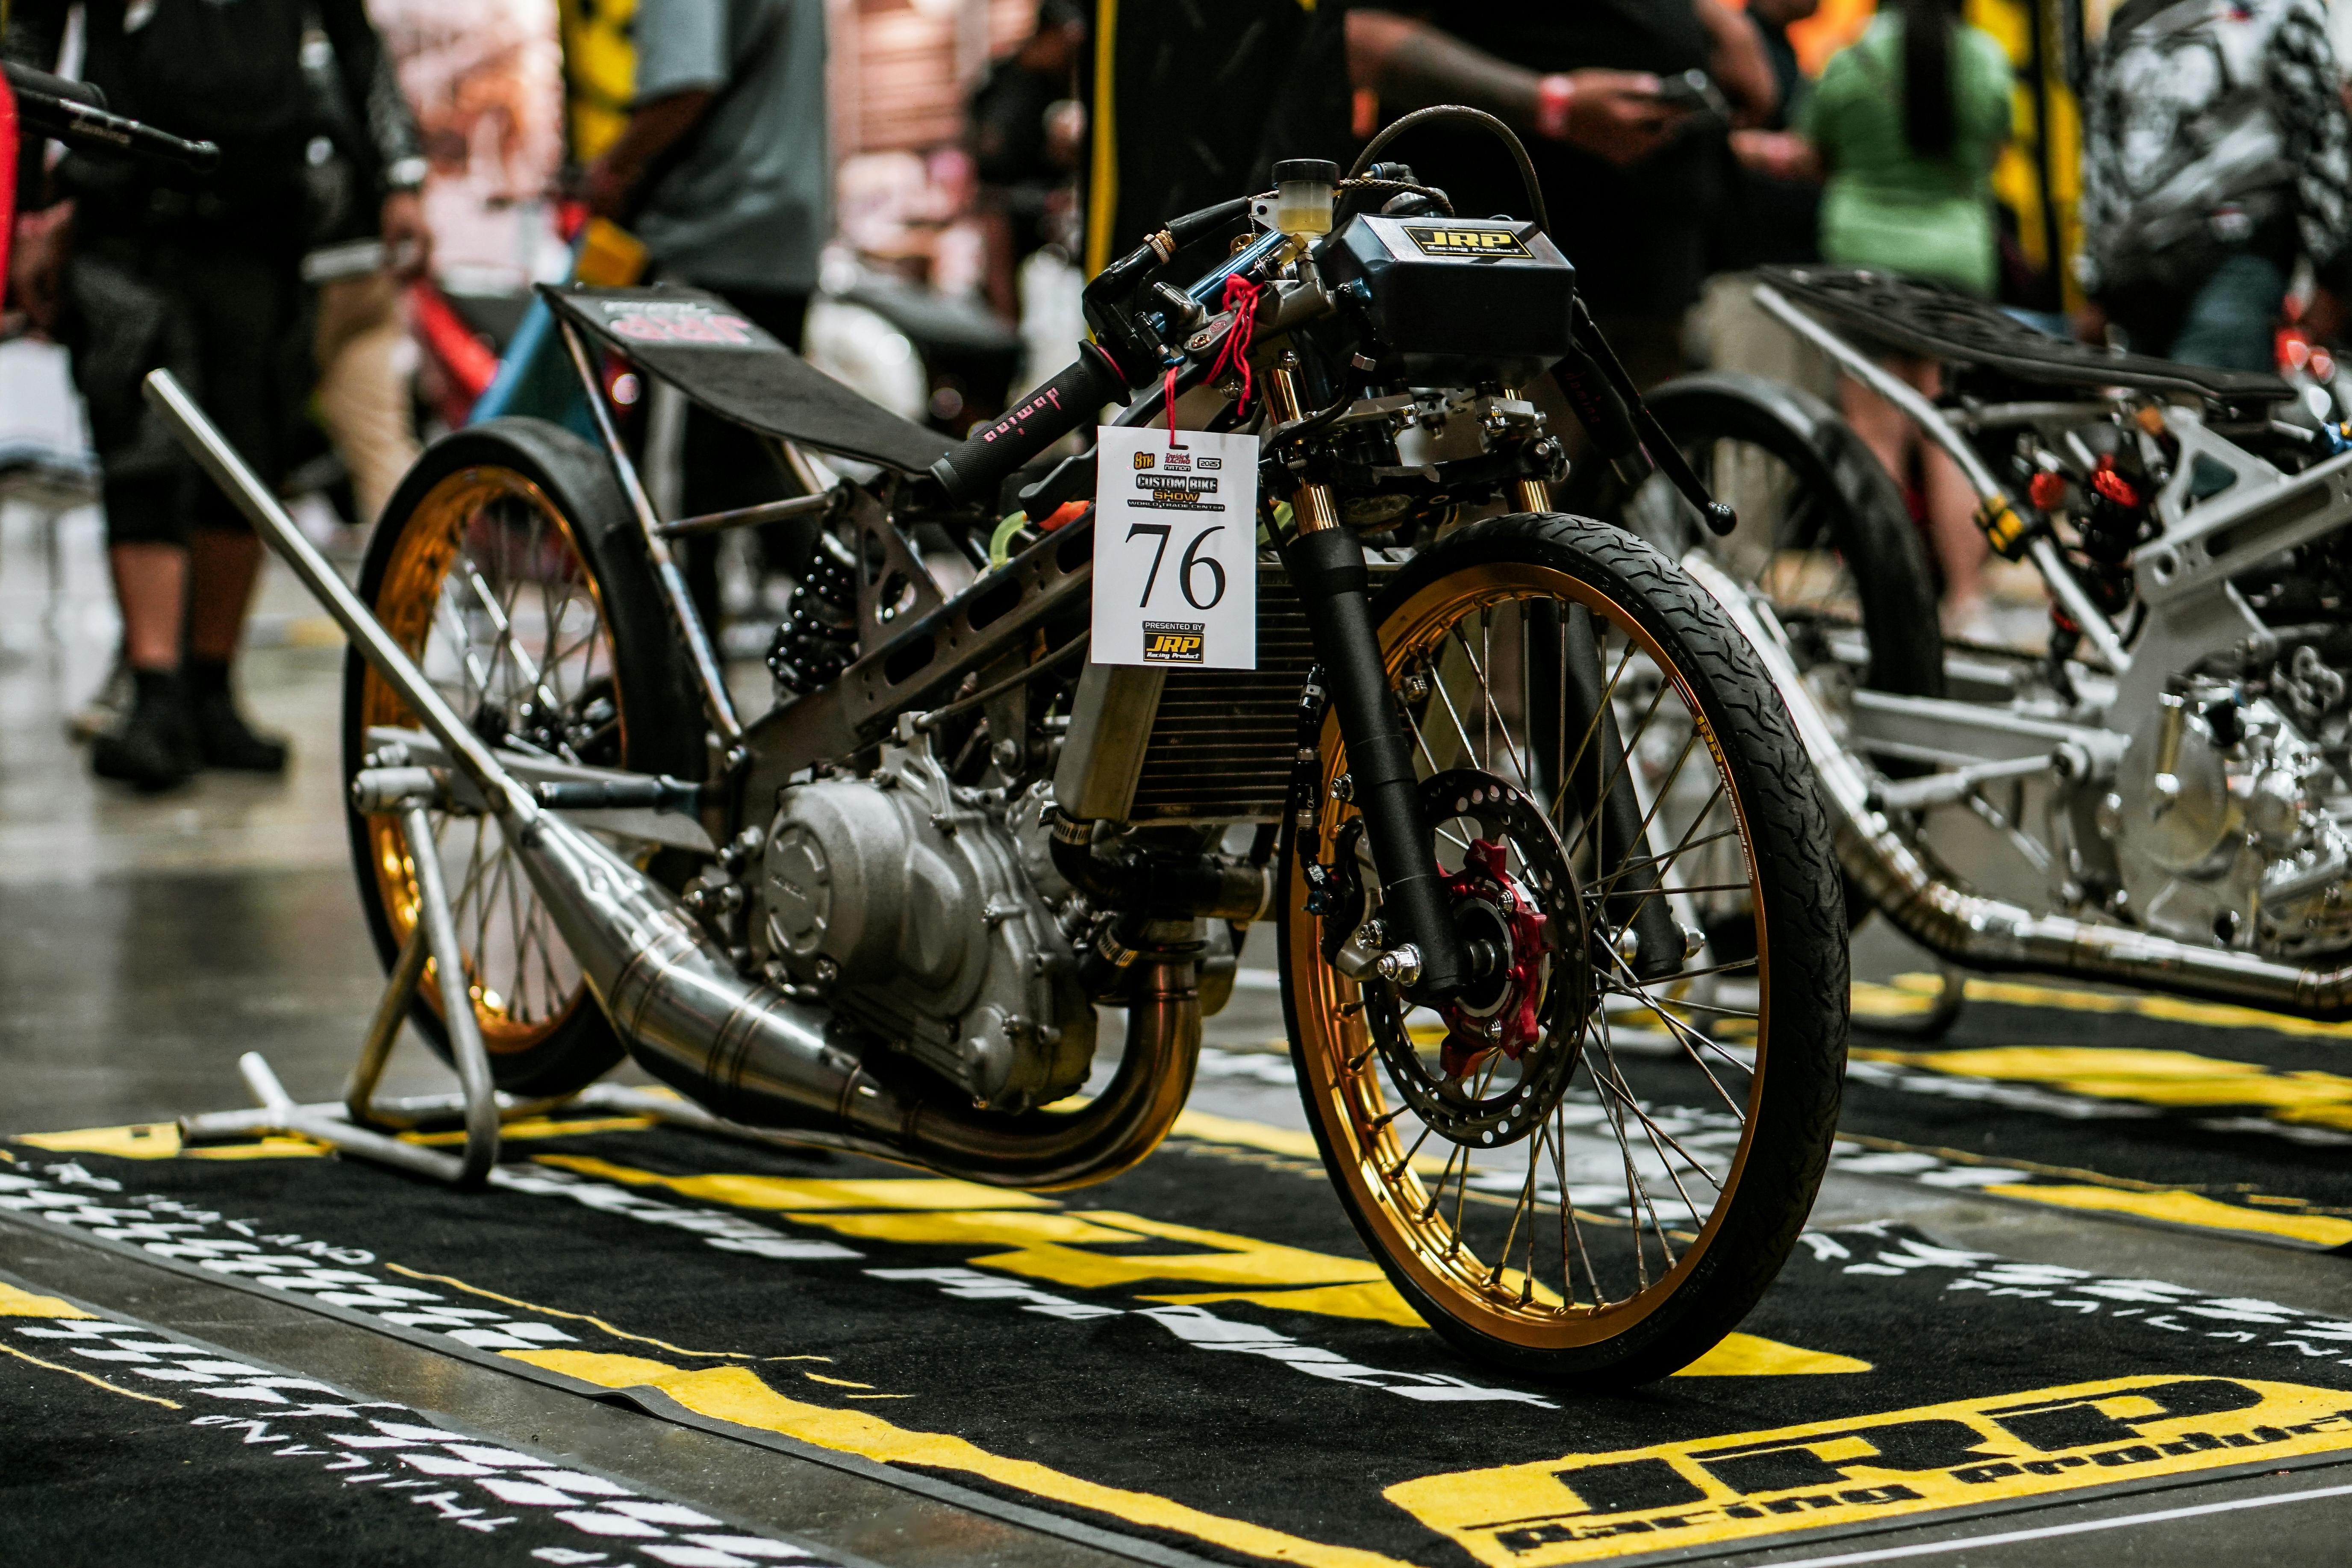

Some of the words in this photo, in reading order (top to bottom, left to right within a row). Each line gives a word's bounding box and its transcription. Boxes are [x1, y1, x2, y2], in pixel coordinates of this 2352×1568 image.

[1421, 232, 1511, 247] JRP
[983, 387, 1062, 443] domino
[1134, 452, 1154, 468] 8TH
[1137, 475, 1186, 489] CUSTOM
[1189, 477, 1217, 491] BIKE
[1154, 491, 1199, 501] SHOW
[1125, 523, 1226, 610] 76
[1145, 622, 1190, 630] PRESENTED
[1146, 635, 1201, 653] JRP
[1459, 1379, 2265, 1531] JRP
[1494, 1484, 1927, 1556] Racing
